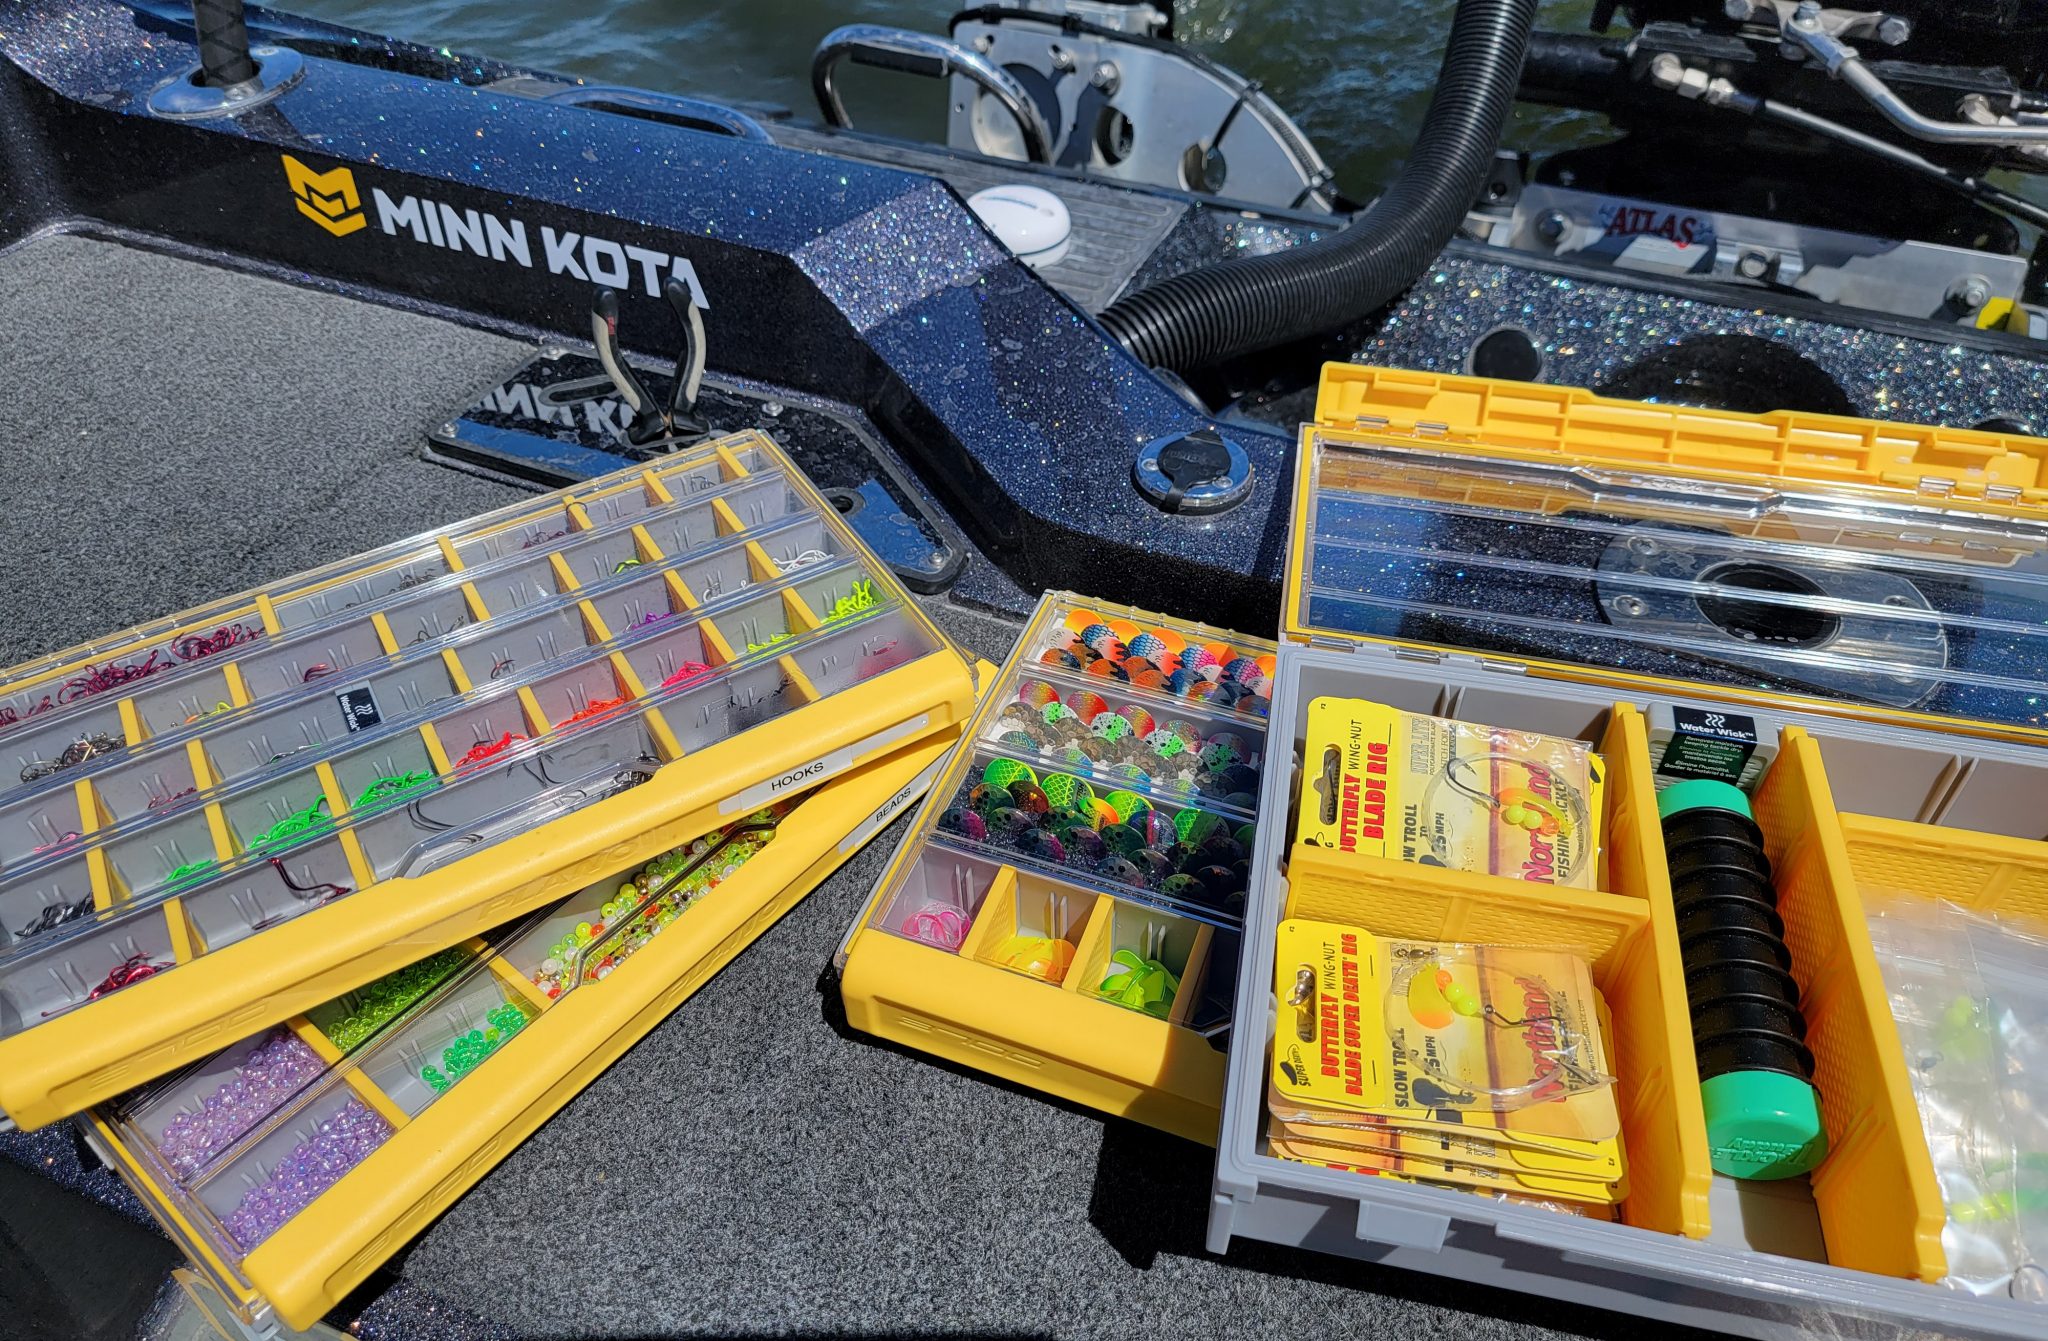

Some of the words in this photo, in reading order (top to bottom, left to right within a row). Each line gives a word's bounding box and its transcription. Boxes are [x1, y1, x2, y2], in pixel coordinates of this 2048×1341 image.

[1604, 206, 1698, 245] ATLAS
[372, 188, 533, 268] MINN
[540, 226, 711, 310] KOTA
[340, 695, 352, 714] Water
[1348, 719, 1363, 770] WING-NUT
[1679, 722, 1715, 734] Water
[1686, 736, 1714, 744] Removes
[771, 762, 824, 791] HOOKS
[1368, 742, 1388, 775] RIG
[876, 787, 912, 822] BEADS
[1340, 773, 1361, 852] BUTTERFLY
[1363, 779, 1387, 839] BLADE
[1555, 777, 1569, 822] ACKLE
[1404, 804, 1417, 843] TROLL
[1435, 812, 1445, 835] MPH
[1556, 830, 1570, 878] FISHIN
[1341, 933, 1358, 956] RIG
[1323, 941, 1337, 990] WING-NUT
[1321, 992, 1340, 1078] BUTTERFLY
[1343, 1003, 1361, 1048] SUPER
[1514, 977, 1567, 1102] Northland
[1425, 1036, 1437, 1057] MPH
[1295, 1064, 1312, 1087] SUPER
[1344, 1048, 1363, 1096] BLADE
[1393, 1069, 1409, 1107] SLOW
